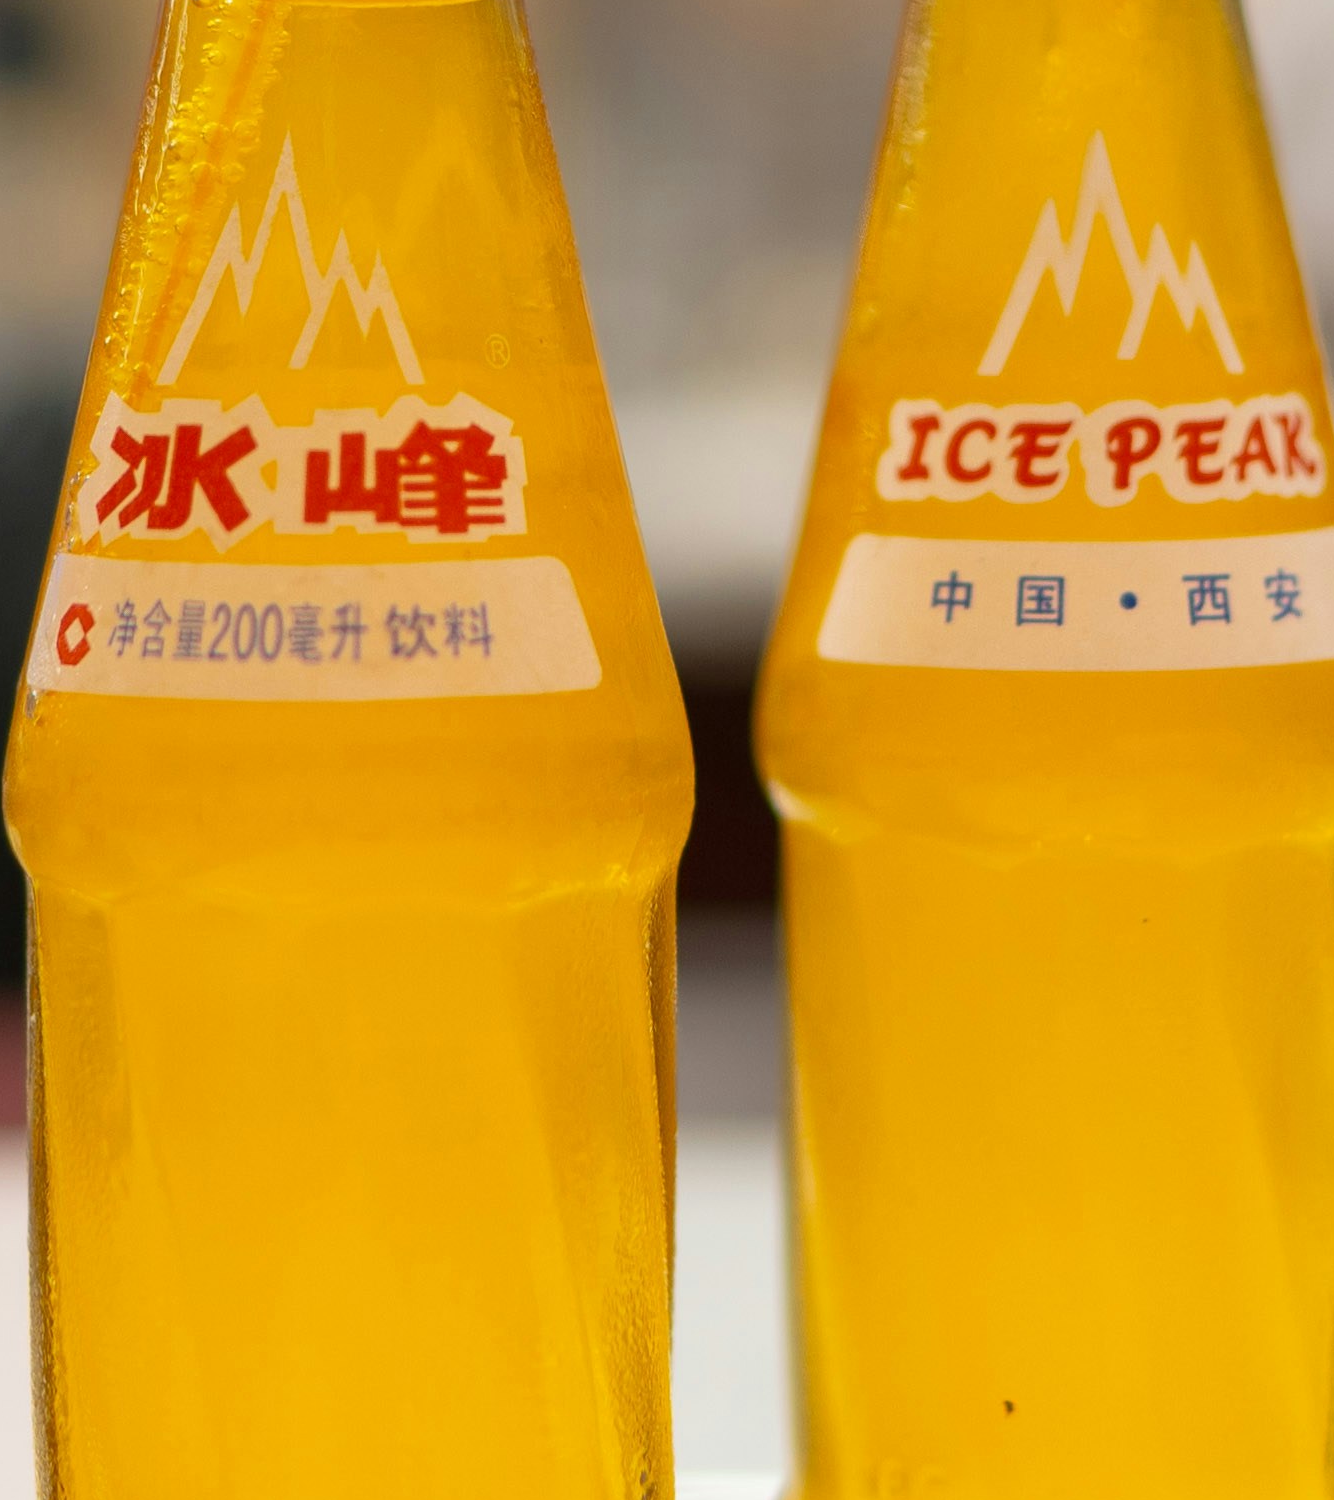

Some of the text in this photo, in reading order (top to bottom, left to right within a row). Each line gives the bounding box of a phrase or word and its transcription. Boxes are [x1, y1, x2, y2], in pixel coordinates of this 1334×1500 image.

[95, 419, 507, 534] 冰峰
[896, 410, 1317, 491] ICE PEAK
[384, 601, 495, 661] 饮料
